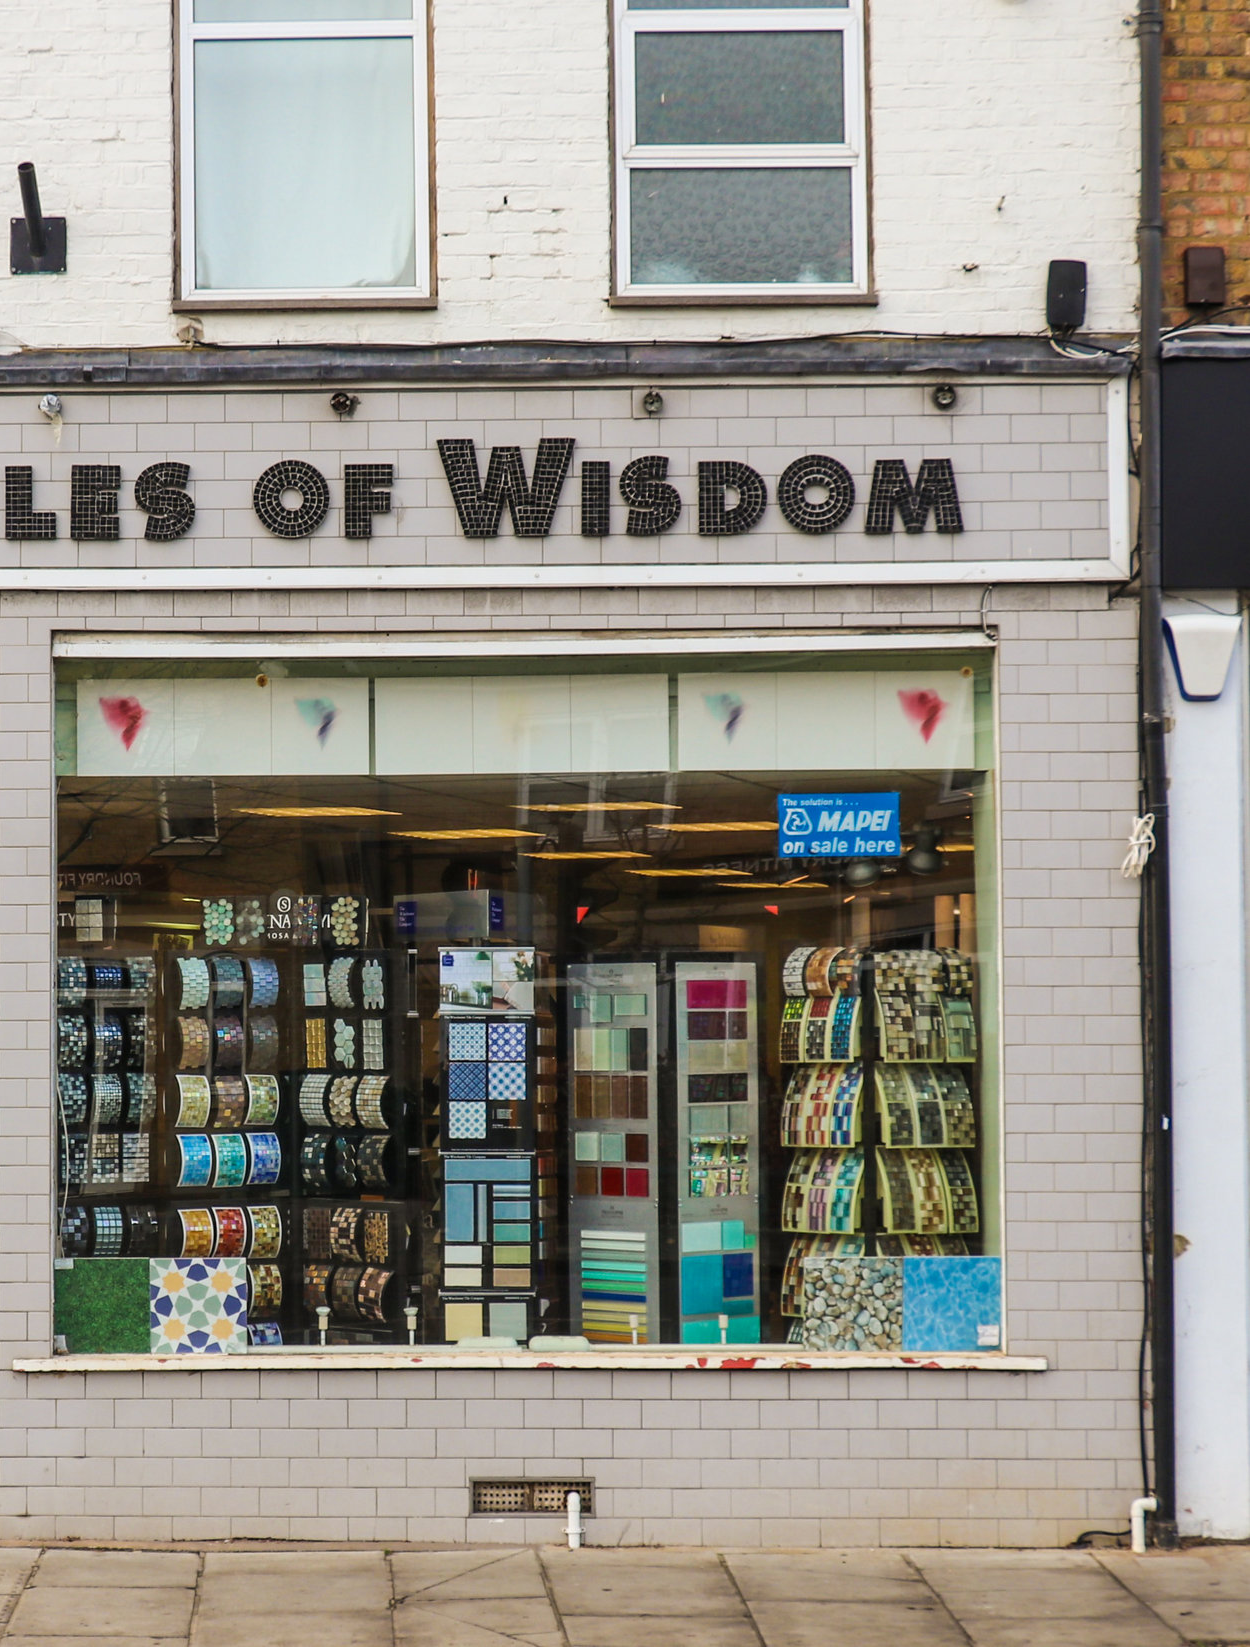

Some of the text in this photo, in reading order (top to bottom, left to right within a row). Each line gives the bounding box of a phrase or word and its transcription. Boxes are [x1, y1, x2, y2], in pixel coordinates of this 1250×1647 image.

[253, 460, 393, 539] OF
[436, 437, 965, 538] WISDOM
[783, 798, 797, 806] The
[800, 798, 833, 806] solution
[817, 810, 892, 832] MAPEI
[783, 836, 896, 854] on sale here
